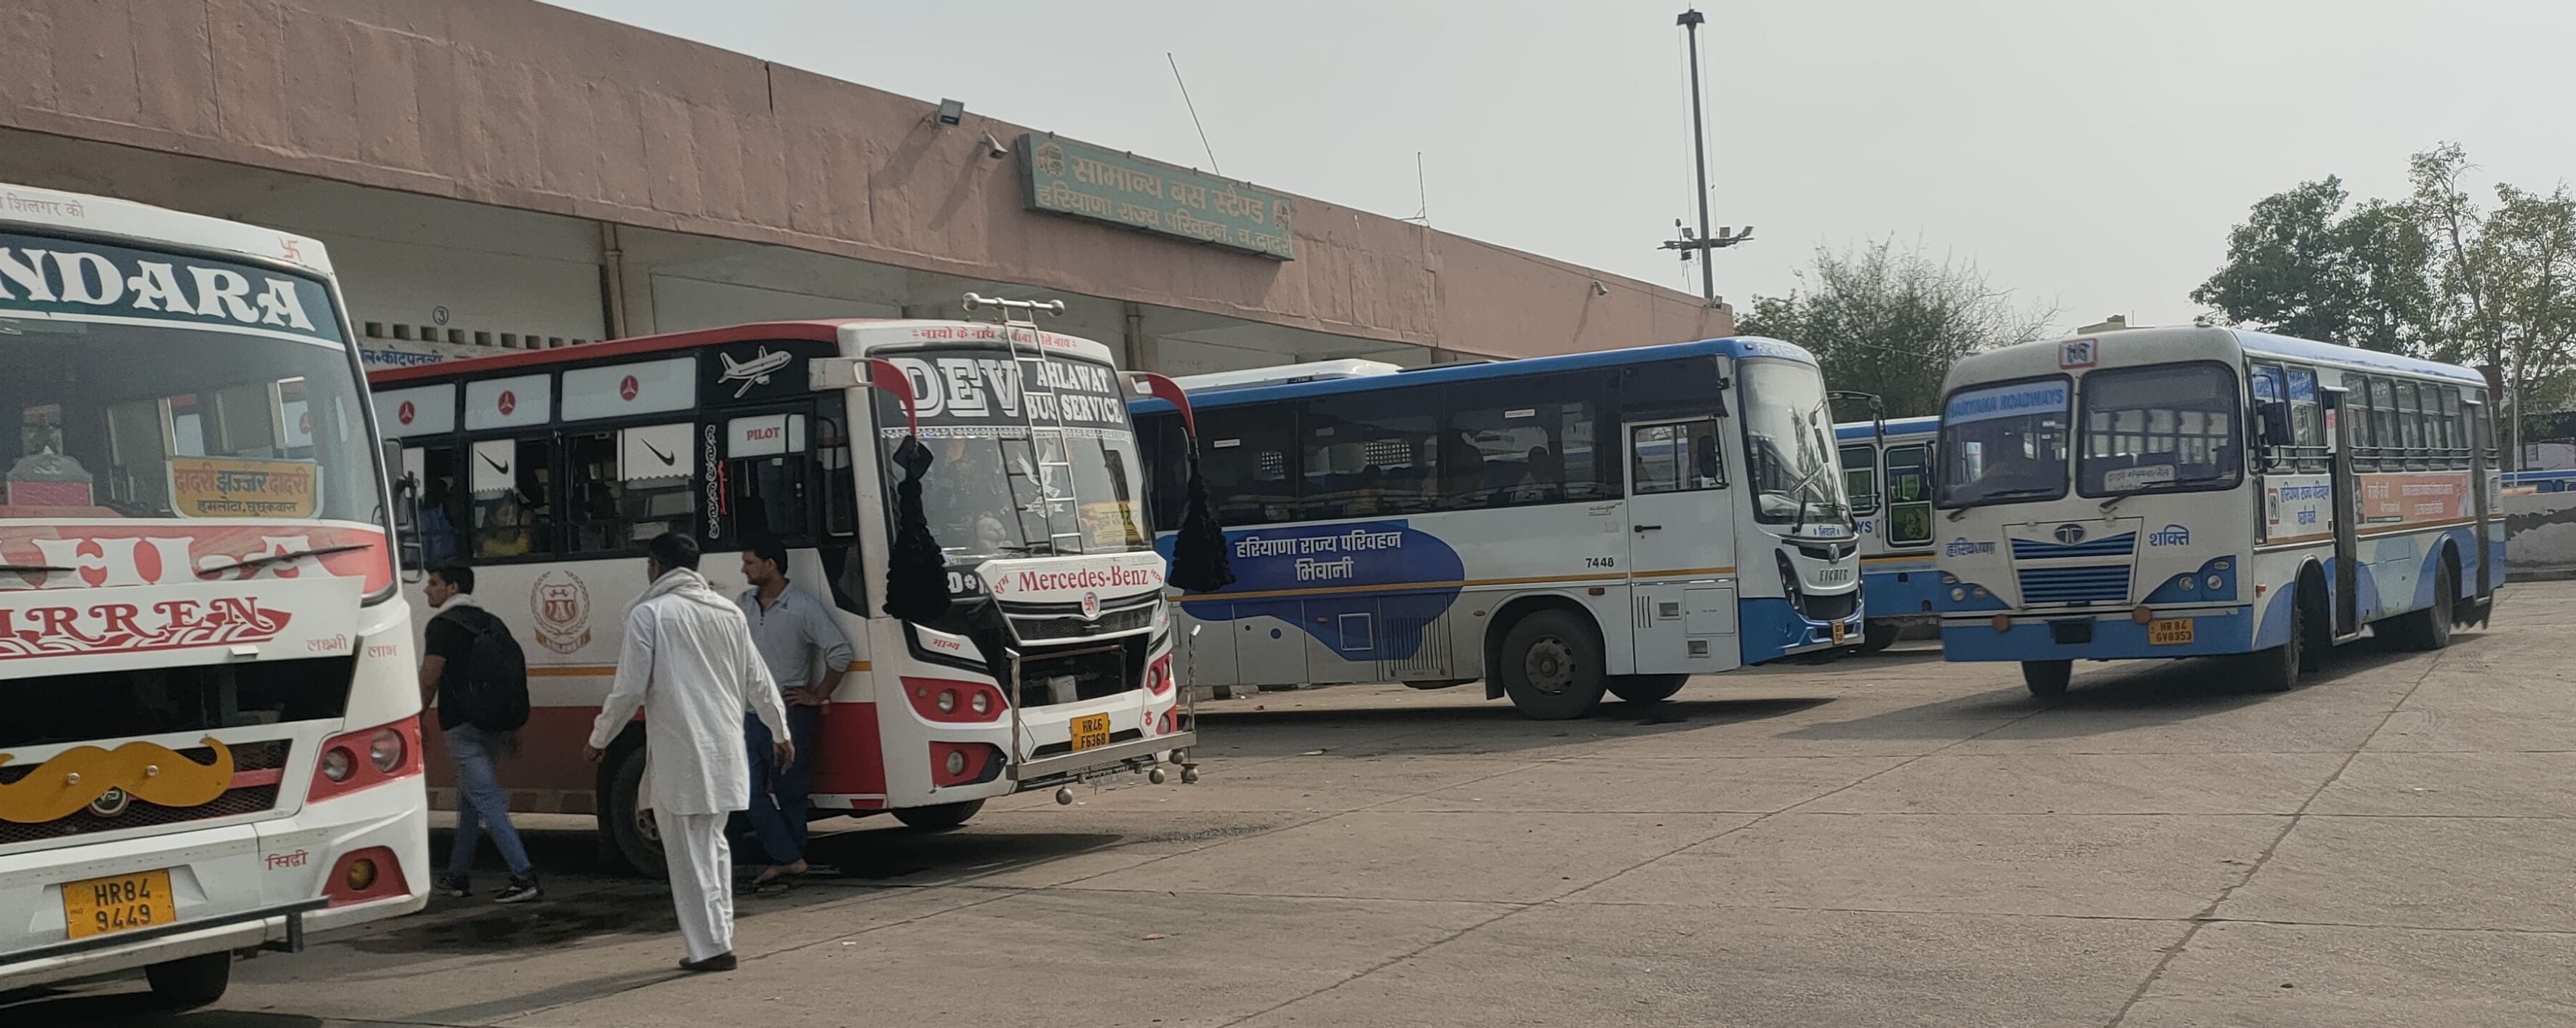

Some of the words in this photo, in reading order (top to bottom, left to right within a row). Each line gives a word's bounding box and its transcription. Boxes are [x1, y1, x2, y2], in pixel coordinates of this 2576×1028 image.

[1070, 154, 1163, 198] सामान्य
[1170, 180, 1208, 209] बस
[1037, 180, 1112, 217] हरियाणा
[1118, 201, 1160, 227] राज्य
[888, 357, 1024, 417] DEV
[1037, 361, 1110, 393] AHLAWAT
[1026, 395, 1057, 420] BUS
[1061, 394, 1123, 424] SERVICE
[746, 427, 780, 441] PILOT
[217, 470, 269, 494] झज्जर
[1235, 536, 1296, 558] हरियाणा
[1299, 535, 1338, 555] राज्य
[1339, 529, 1402, 552] परिवहन
[2148, 523, 2190, 547] शक्ति
[1295, 556, 1355, 582] भिवानी
[1586, 557, 1614, 569] 7448
[1019, 566, 1149, 593] Mercedes-Benz
[1082, 733, 1106, 749] F6368
[94, 878, 151, 907] HR84
[96, 904, 152, 932] 9449
